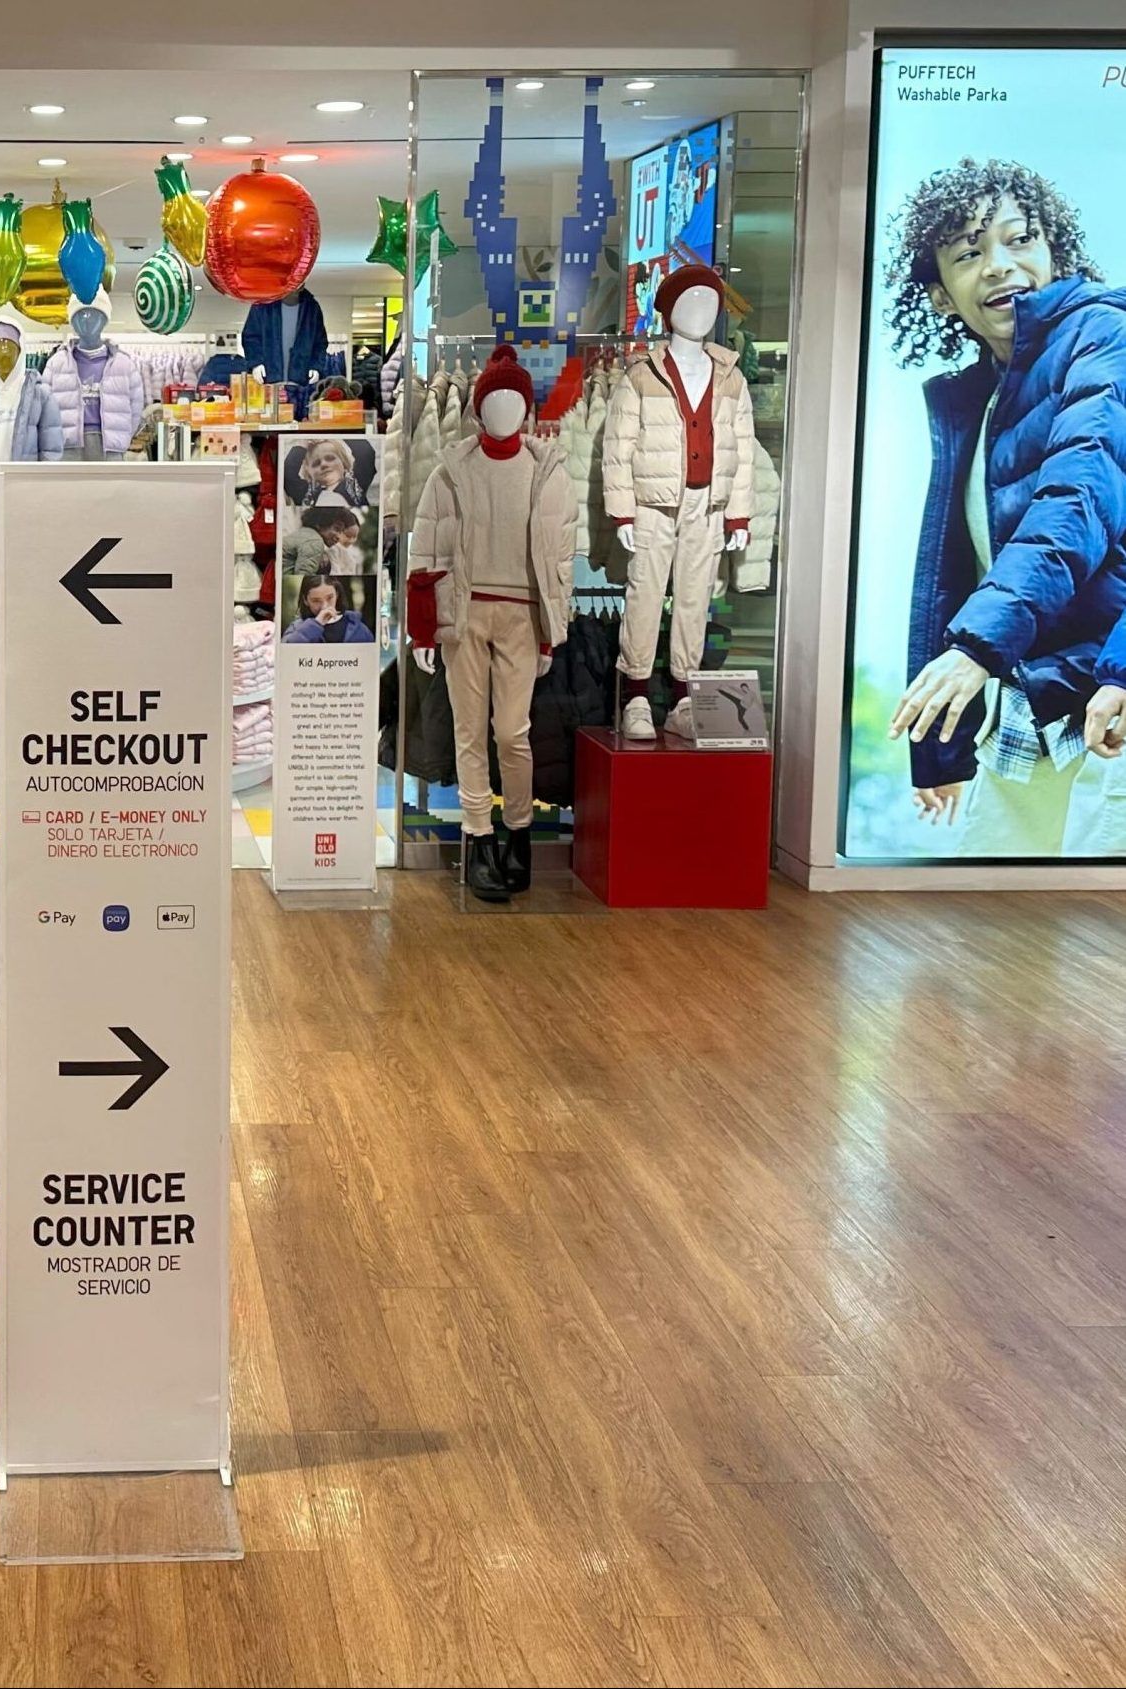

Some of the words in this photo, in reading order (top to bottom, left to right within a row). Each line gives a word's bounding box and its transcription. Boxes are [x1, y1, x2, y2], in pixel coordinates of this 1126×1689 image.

[898, 65, 976, 80] PUFFTECH
[897, 86, 961, 101] Washable
[967, 87, 1008, 101] Parka
[636, 186, 659, 251] UT
[298, 657, 313, 668] Kid
[316, 657, 359, 669] Approved
[70, 690, 161, 722] SELF
[22, 733, 208, 765] CHECKOUT
[45, 811, 84, 824] CARD
[89, 811, 95, 824] /
[100, 810, 166, 824] E-MONEY
[172, 810, 207, 823] ONLY
[48, 828, 84, 841] SOLO
[90, 827, 153, 841] TARJETA
[159, 828, 164, 841] /
[317, 836, 334, 844] UNI
[48, 844, 98, 858] DINERO
[317, 844, 334, 853] QLO
[314, 857, 337, 867] KIDS
[53, 911, 76, 927] Pay
[106, 914, 127, 925] pay
[170, 912, 190, 924] Pay
[42, 1172, 186, 1205] SERVICE
[32, 1214, 195, 1246] COUNTER
[47, 1256, 151, 1273] MOSTRADOR
[158, 1254, 181, 1271] DE
[77, 1278, 151, 1296] SERVICIO
